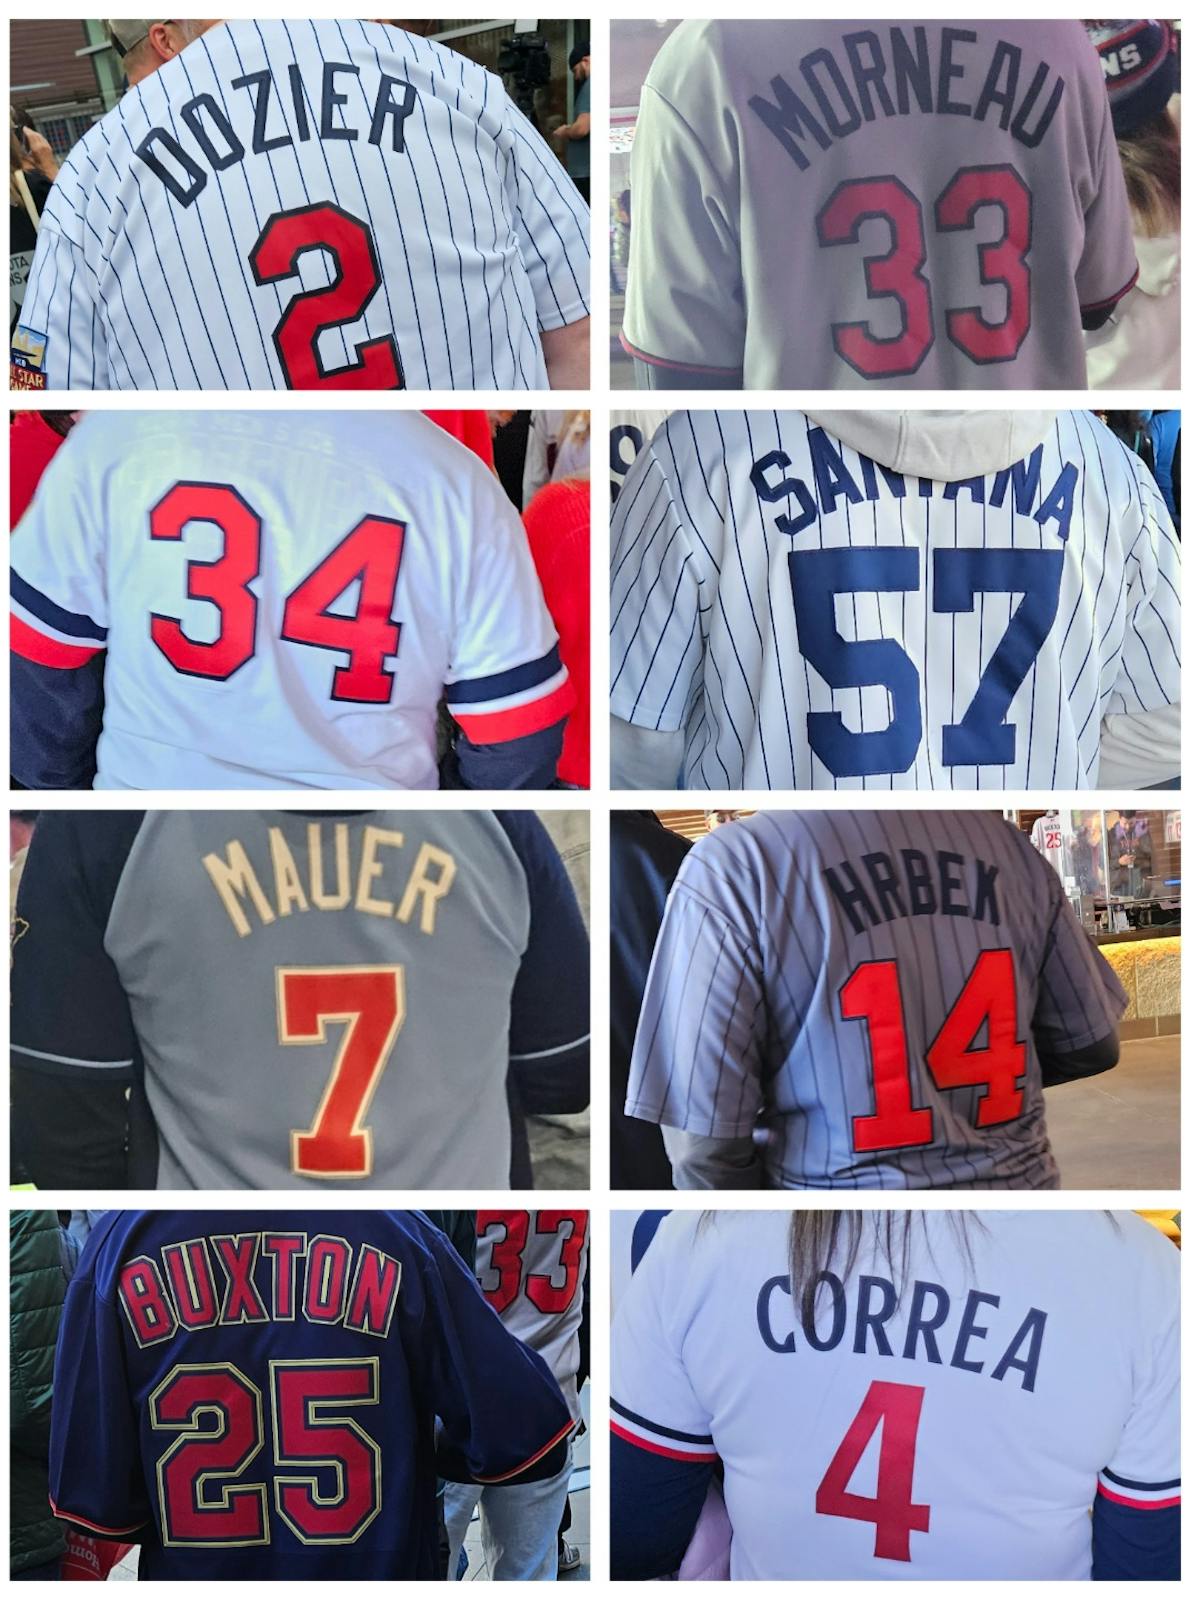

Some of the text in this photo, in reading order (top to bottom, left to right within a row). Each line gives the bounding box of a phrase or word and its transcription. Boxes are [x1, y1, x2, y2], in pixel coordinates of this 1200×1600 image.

[134, 61, 416, 208] DOZIER
[748, 26, 1065, 171] MORNEAU
[248, 200, 404, 390] 2
[815, 162, 1033, 380] 33
[749, 426, 1079, 541] SANNA
[149, 479, 408, 704] 34
[788, 546, 1066, 777] 57
[202, 822, 457, 938] MAUER
[823, 848, 1002, 935] HRBEK
[274, 964, 406, 1179] 7
[839, 948, 1028, 1154] 14
[118, 1231, 402, 1349] BUXTON
[475, 1210, 589, 1314] 33
[756, 1269, 1049, 1393] CORREA
[148, 1356, 381, 1549] 25
[815, 1379, 931, 1563] 4
